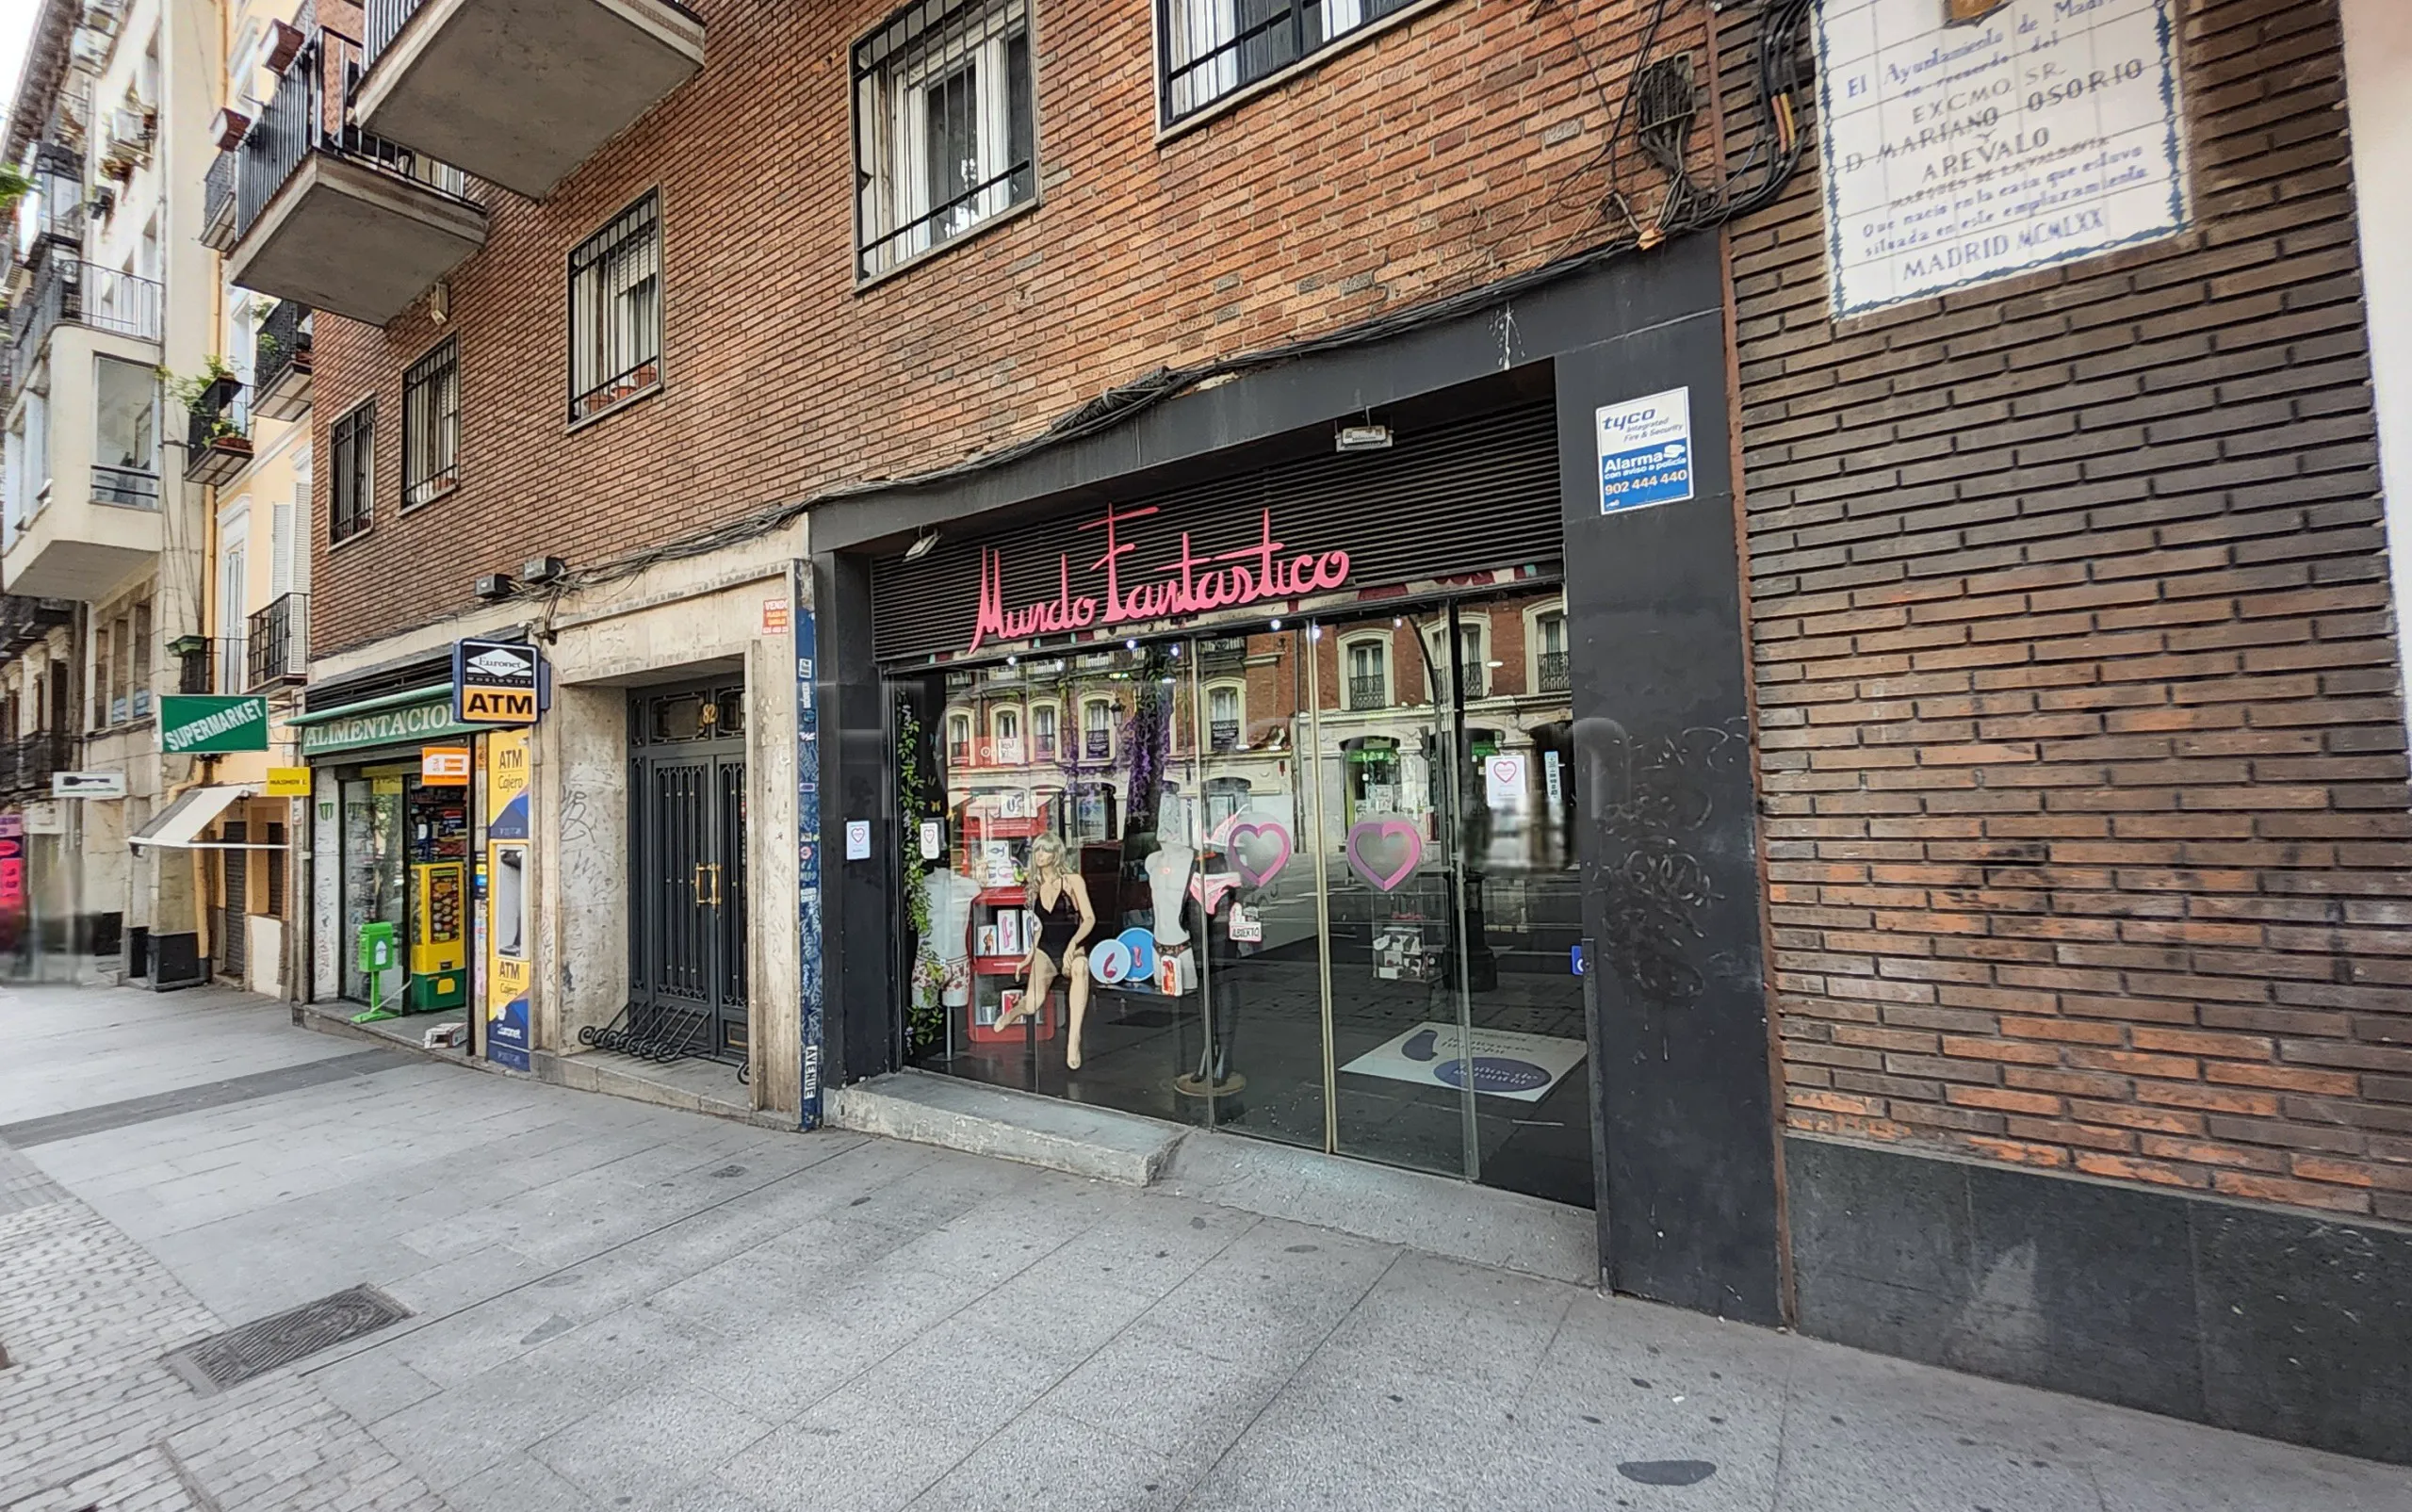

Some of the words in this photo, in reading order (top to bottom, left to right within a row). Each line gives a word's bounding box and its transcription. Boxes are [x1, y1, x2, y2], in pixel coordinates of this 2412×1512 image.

[1848, 74, 1867, 98] El
[2018, 13, 2038, 35] de
[1876, 106, 1998, 164] MARIANO
[2028, 58, 2143, 111] OSORIO
[1975, 127, 1997, 143] Y
[1922, 126, 2050, 184] AREVALO
[2046, 167, 2078, 188] que
[1903, 234, 2010, 281] MADRID
[1602, 407, 1656, 431] tyco
[1626, 416, 1670, 433] Integrated
[1641, 430, 1648, 439] &
[1650, 423, 1685, 436] Security
[1604, 451, 1664, 473] Alarma
[1605, 481, 1630, 496] 902
[1632, 475, 1658, 490] 444
[1660, 469, 1687, 483] 440
[1077, 501, 1350, 624] Fantastico
[969, 545, 1098, 656] Mundo
[479, 656, 521, 669] Euronet
[467, 692, 533, 715] ATM
[164, 698, 264, 751] SUPERMARKET
[498, 748, 523, 769] ATM
[497, 773, 524, 792] Cajero
[498, 961, 520, 981] ATM
[806, 1049, 817, 1097] AVENUE
